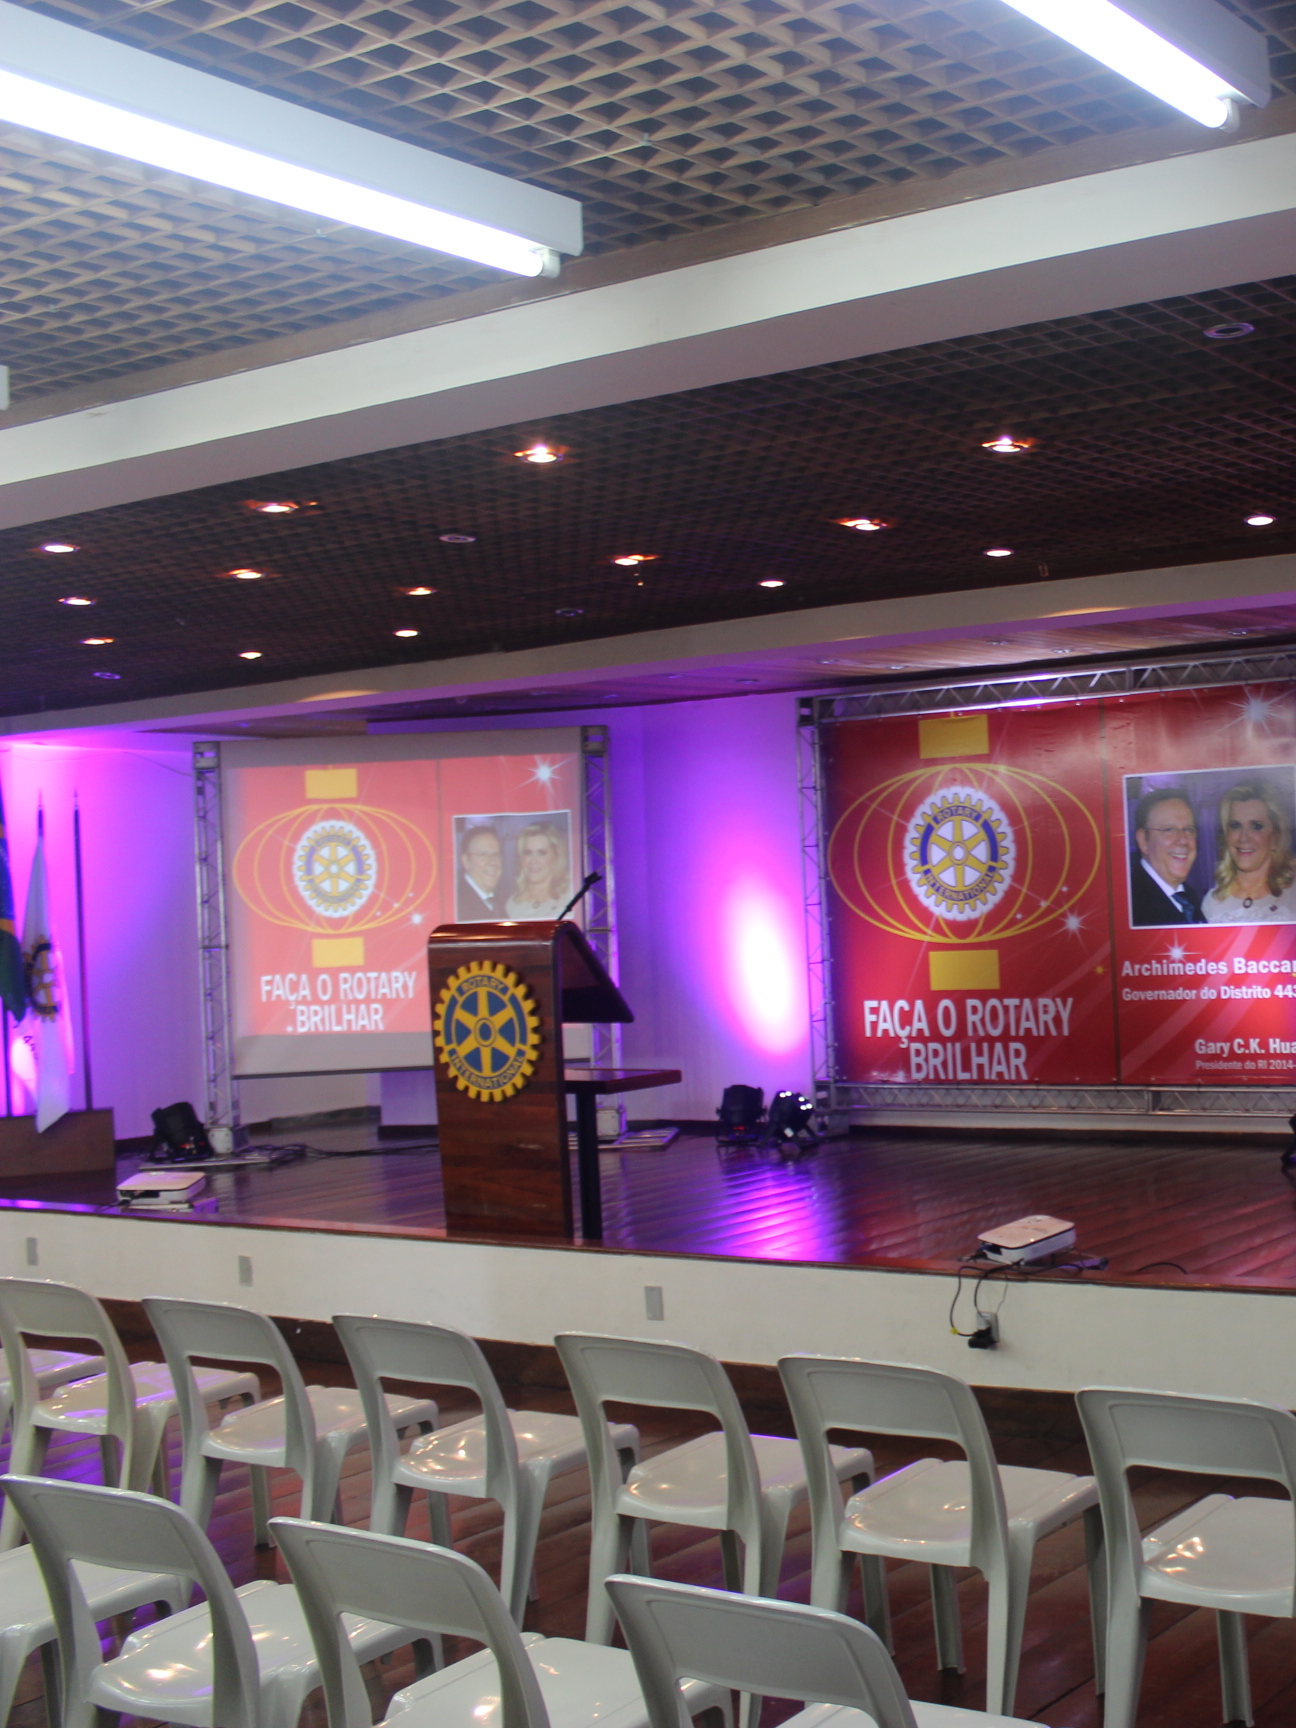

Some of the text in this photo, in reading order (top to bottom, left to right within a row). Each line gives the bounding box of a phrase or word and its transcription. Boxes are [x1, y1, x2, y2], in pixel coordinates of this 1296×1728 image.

[1121, 959, 1229, 977] Archimedes
[260, 971, 417, 1009] FAÇA O ROTARY
[460, 976, 505, 993] ROTARY
[1122, 987, 1197, 1001] Governador
[1200, 987, 1217, 1000] do
[1220, 985, 1271, 1000] Distrito
[296, 1003, 384, 1032] BRILHAR
[863, 998, 1073, 1048] FAÇA O ROTARY
[1195, 1039, 1231, 1057] Gary
[1233, 1038, 1266, 1054] C.K.
[450, 1053, 527, 1090] INTERNATIONAL
[910, 1042, 1028, 1080] BRILHAR
[1195, 1060, 1242, 1070] Presidente
[1244, 1060, 1256, 1070] do
[1257, 1060, 1268, 1070] RI
